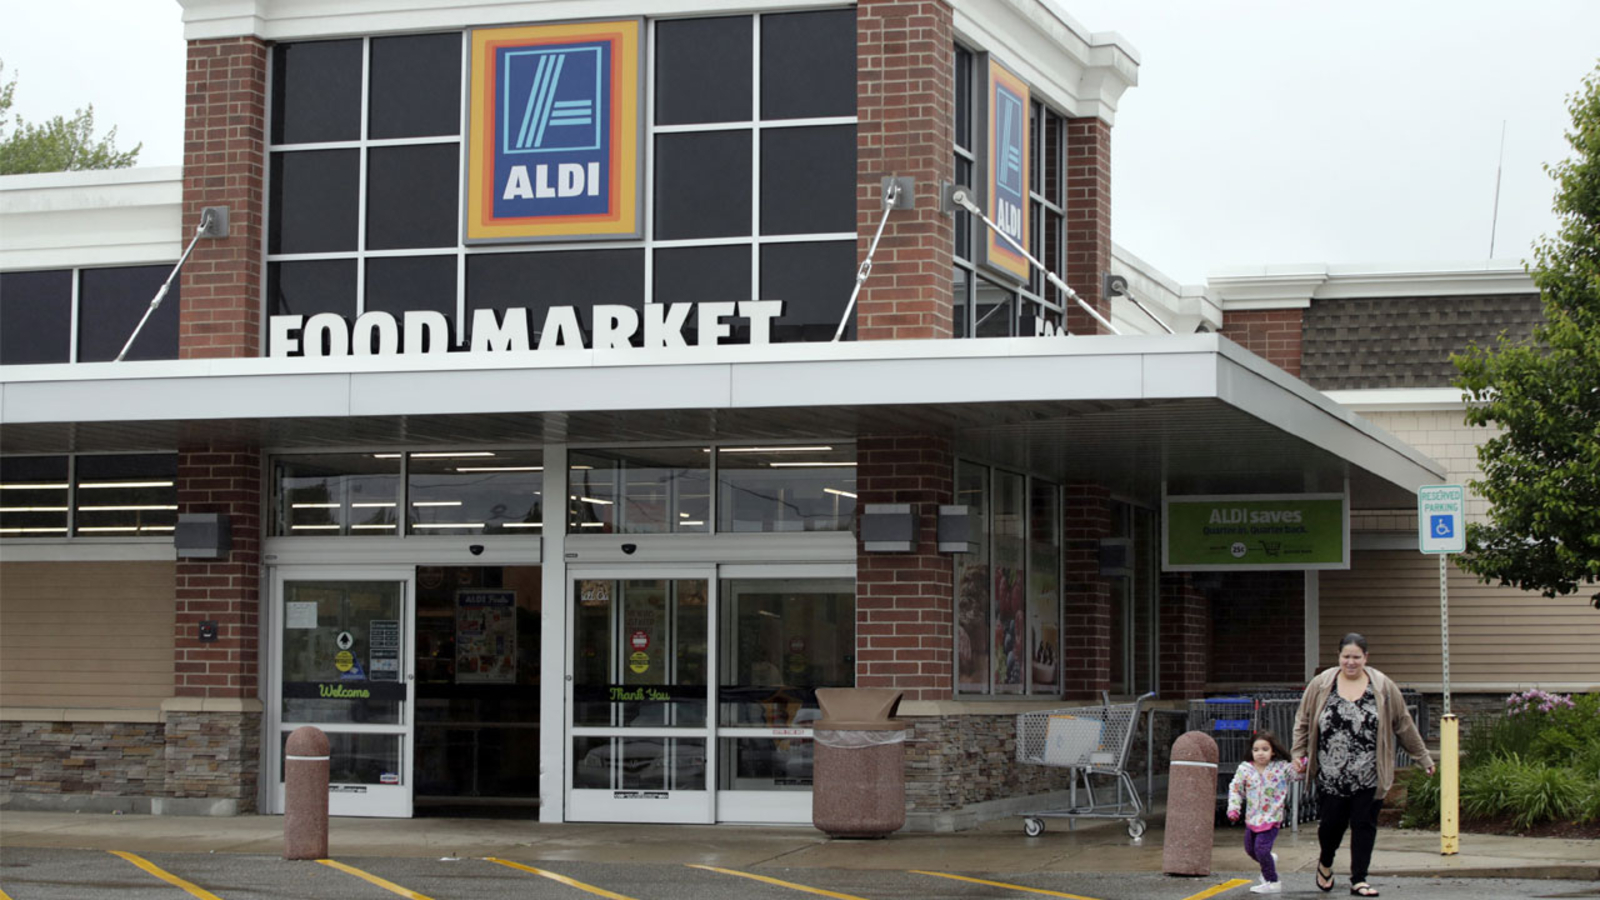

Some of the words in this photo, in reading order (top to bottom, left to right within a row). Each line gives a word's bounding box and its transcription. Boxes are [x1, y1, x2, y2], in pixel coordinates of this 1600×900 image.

[503, 162, 600, 200] ALDI
[996, 197, 1021, 240] ALDI
[269, 310, 449, 358] FOOD
[470, 300, 784, 352] MARKET
[1422, 490, 1461, 501] RESERVED
[1425, 503, 1459, 512] PARKING
[1209, 508, 1247, 524] ALDI
[1249, 508, 1302, 524] saves
[319, 683, 370, 699] Welcome
[609, 686, 645, 701] Thank
[645, 687, 671, 701] You
